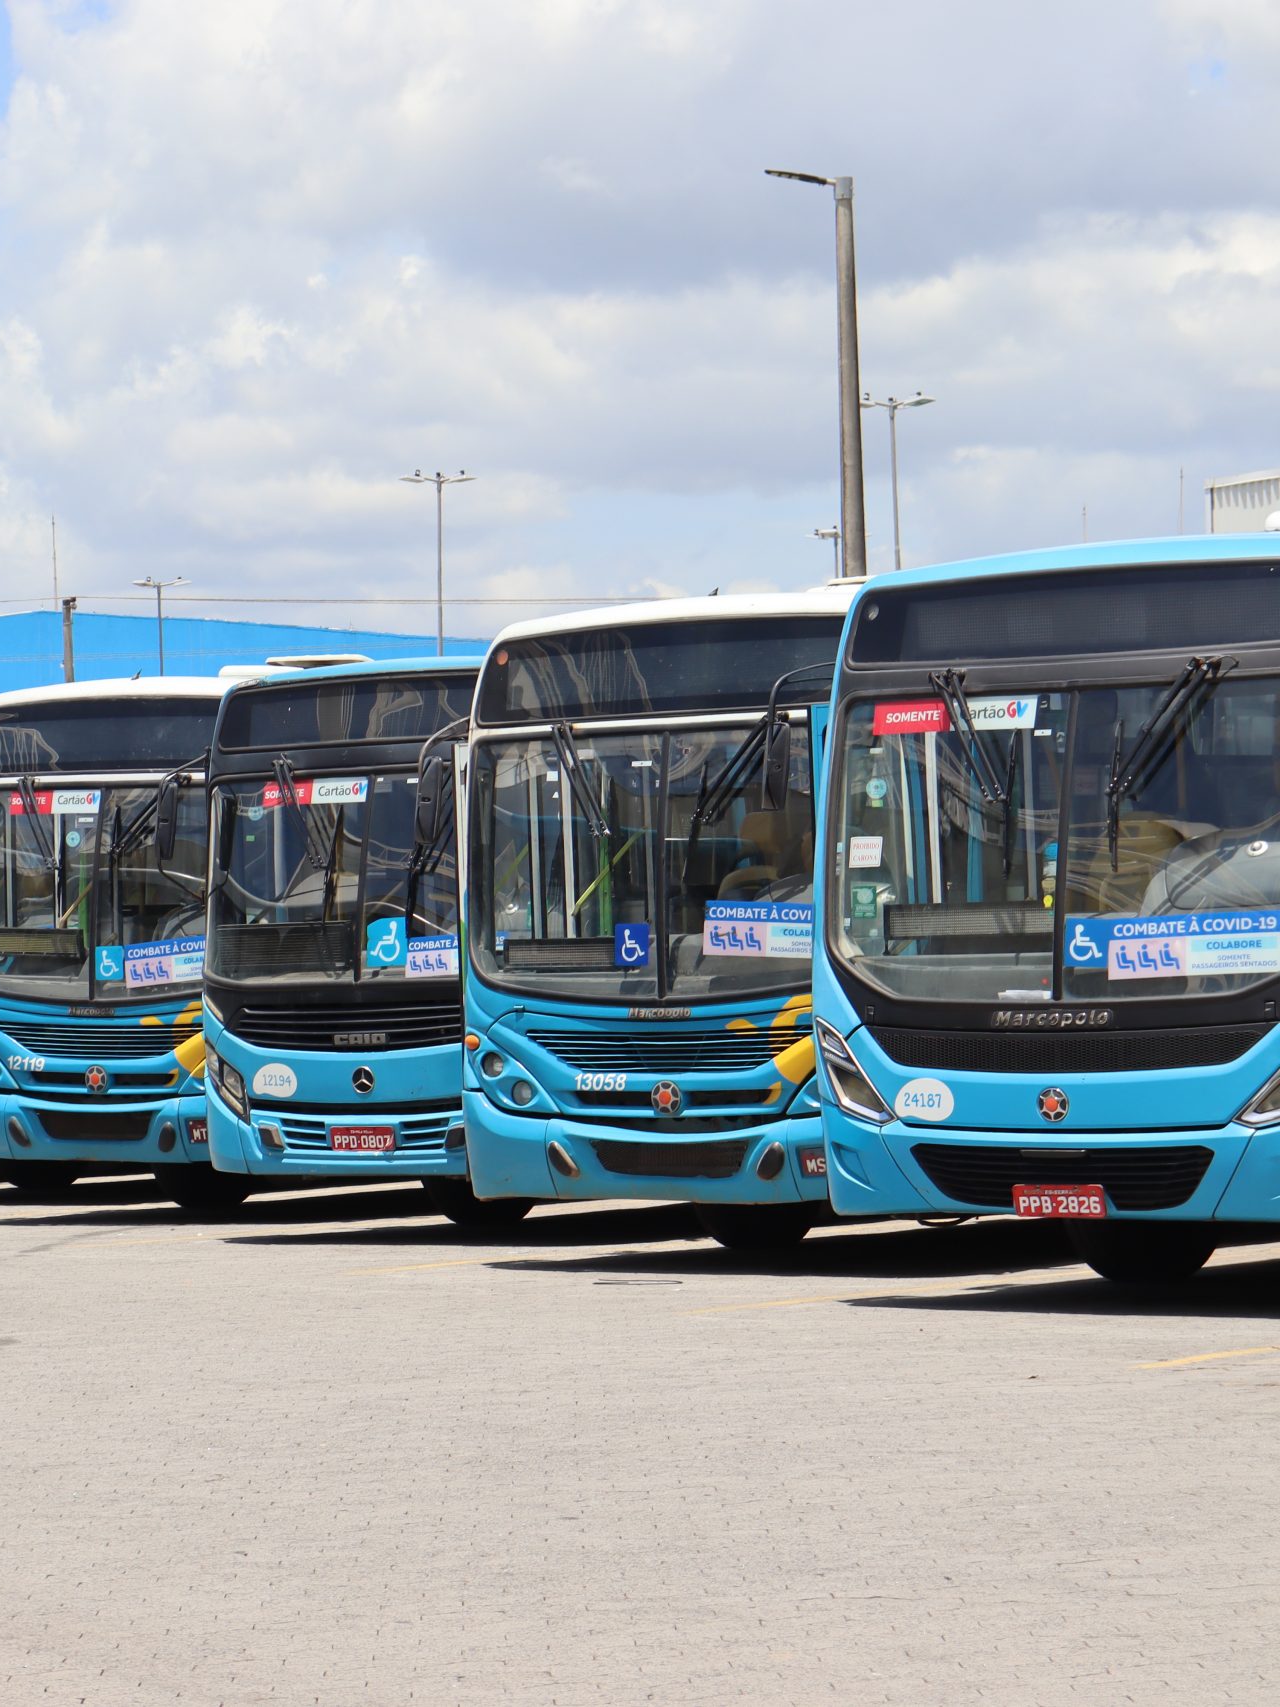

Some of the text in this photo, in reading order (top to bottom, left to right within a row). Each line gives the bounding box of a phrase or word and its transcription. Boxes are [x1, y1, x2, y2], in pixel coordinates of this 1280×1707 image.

[885, 710, 940, 724] SOMENTE
[708, 904, 812, 921] COMBATE À COVI
[782, 928, 813, 937] COLAB
[1113, 916, 1277, 937] COMBATE À COVID-19
[127, 945, 171, 959] COMBATE
[172, 941, 180, 953] À
[408, 939, 452, 951] COMBATE
[1206, 939, 1263, 950] COLABORE
[1191, 959, 1278, 969] PASSAGEIROS SENTADOS
[1217, 953, 1252, 961] SOMENTE
[68, 1006, 115, 1017] Marcopolo
[627, 1006, 692, 1019] Marcopolo
[993, 1009, 1110, 1027] Marcopolo
[333, 1033, 386, 1046] CAIO
[7, 1055, 46, 1072] 12119
[262, 1073, 292, 1088] 12194
[574, 1073, 627, 1091] 13058
[903, 1092, 942, 1109] 24187
[192, 1128, 207, 1140] MT
[806, 1157, 826, 1173] MS
